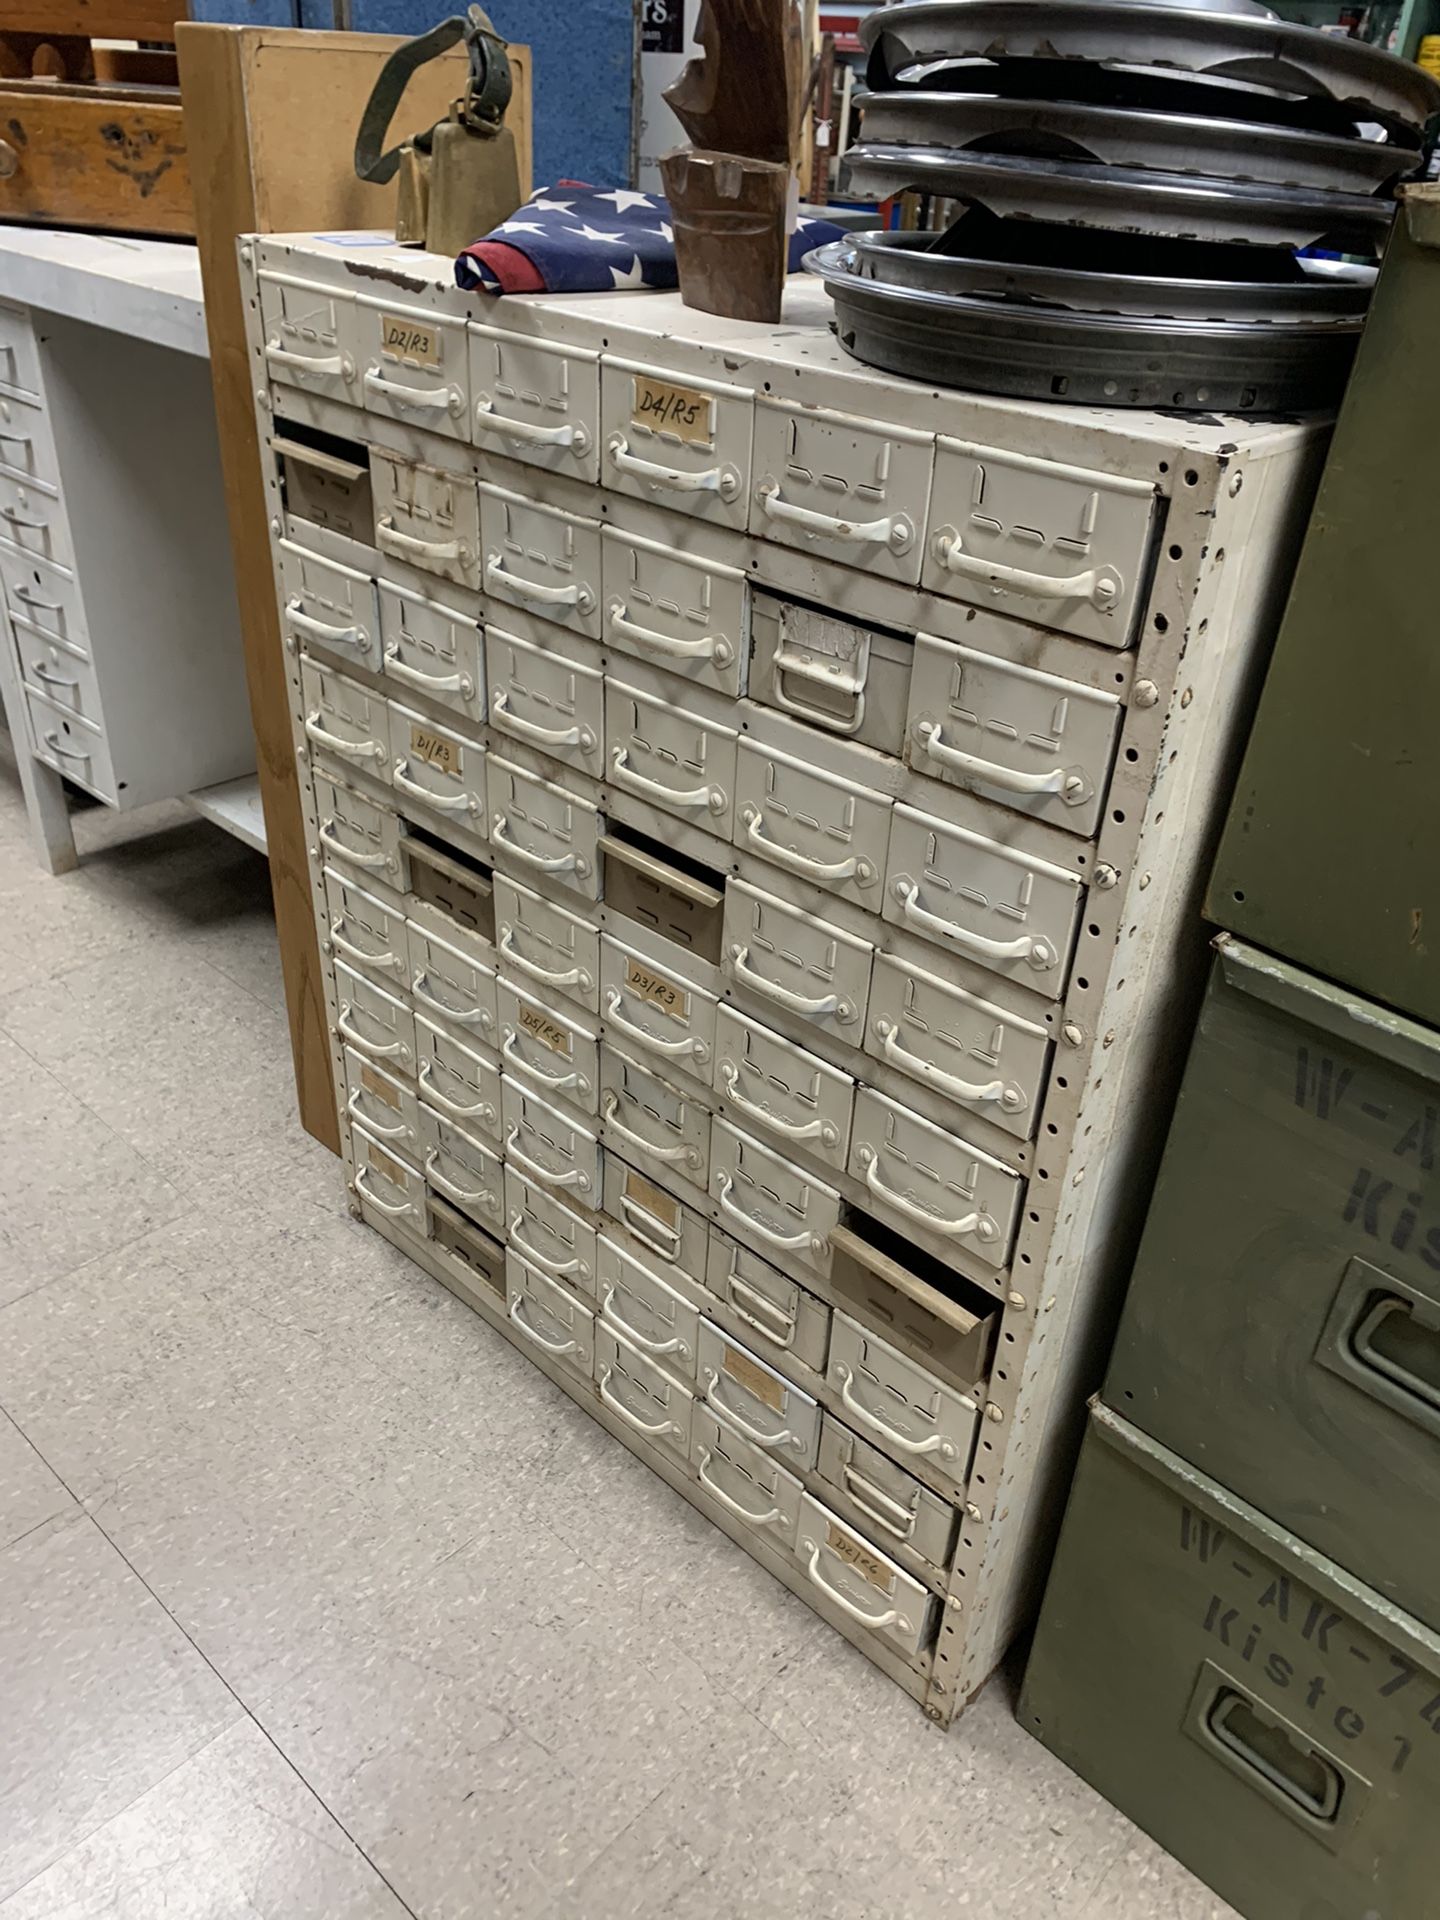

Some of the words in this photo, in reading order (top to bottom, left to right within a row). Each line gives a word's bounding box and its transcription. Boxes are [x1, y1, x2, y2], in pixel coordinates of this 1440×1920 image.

[388, 328, 429, 353] D2/R3
[640, 391, 700, 424] D4/R5
[417, 736, 450, 761] D1/R3
[631, 972, 676, 1005] D3/R3
[1203, 1595, 1365, 1739] Kiste
